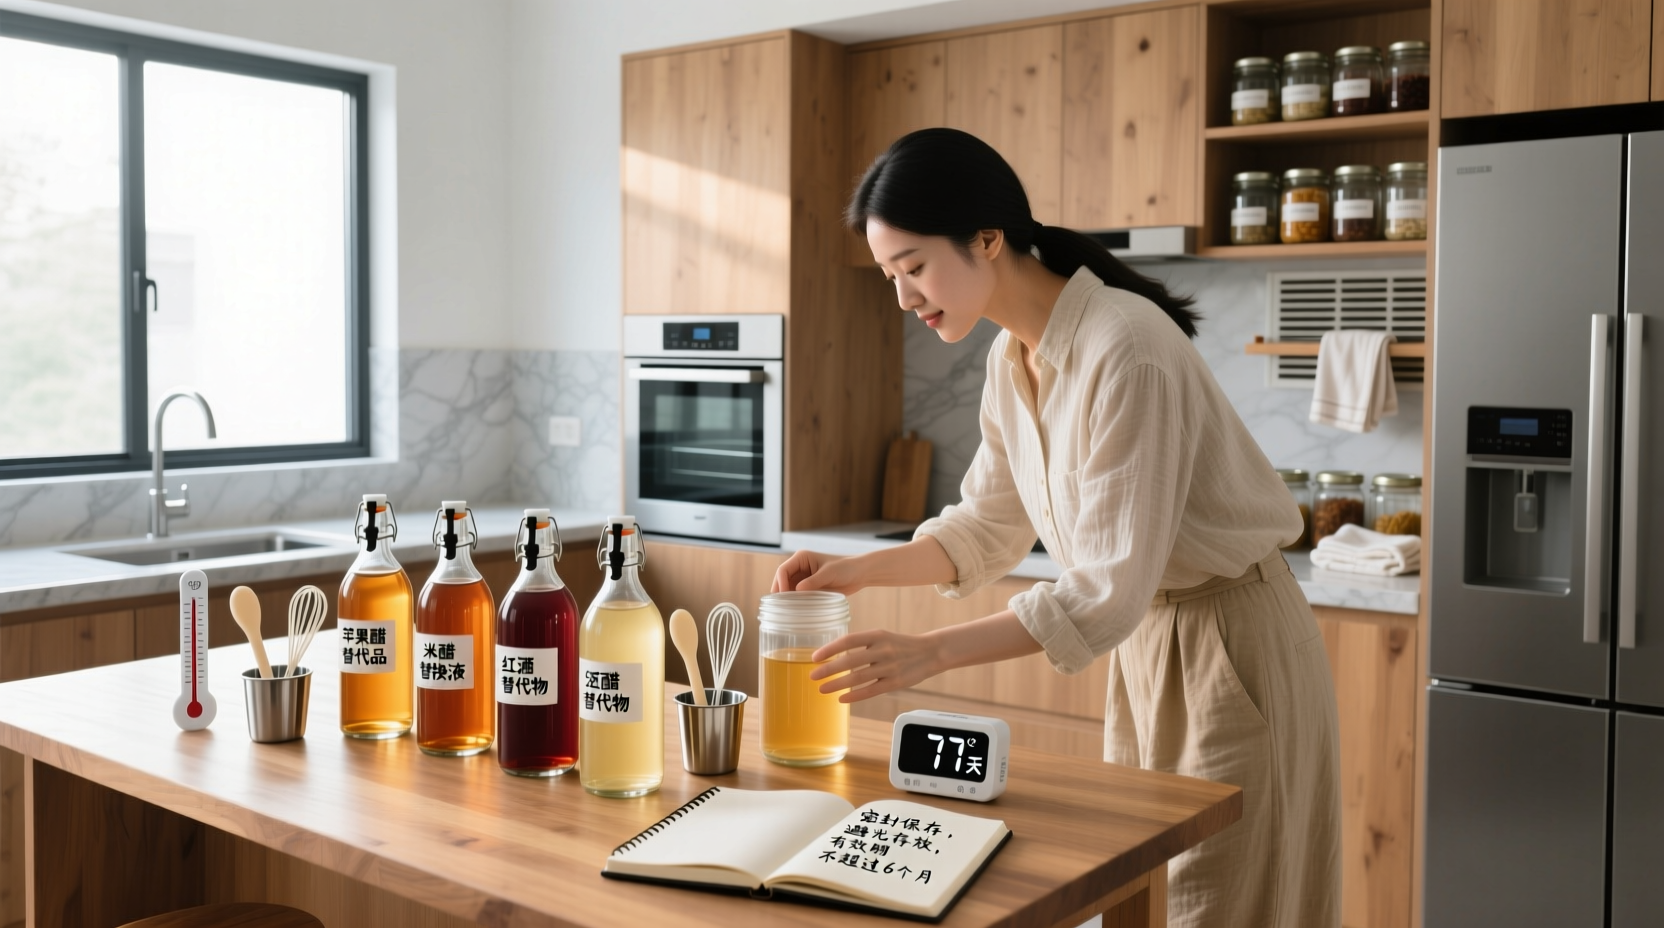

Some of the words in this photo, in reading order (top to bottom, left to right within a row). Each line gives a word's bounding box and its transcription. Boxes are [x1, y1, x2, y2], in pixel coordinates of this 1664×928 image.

[342, 647, 387, 666] 替代品
[423, 641, 456, 660] 米醋
[502, 655, 534, 675] 红酒
[501, 676, 549, 696] 替代物
[583, 692, 630, 713] 替代物
[818, 850, 932, 884] 不超过6个月
